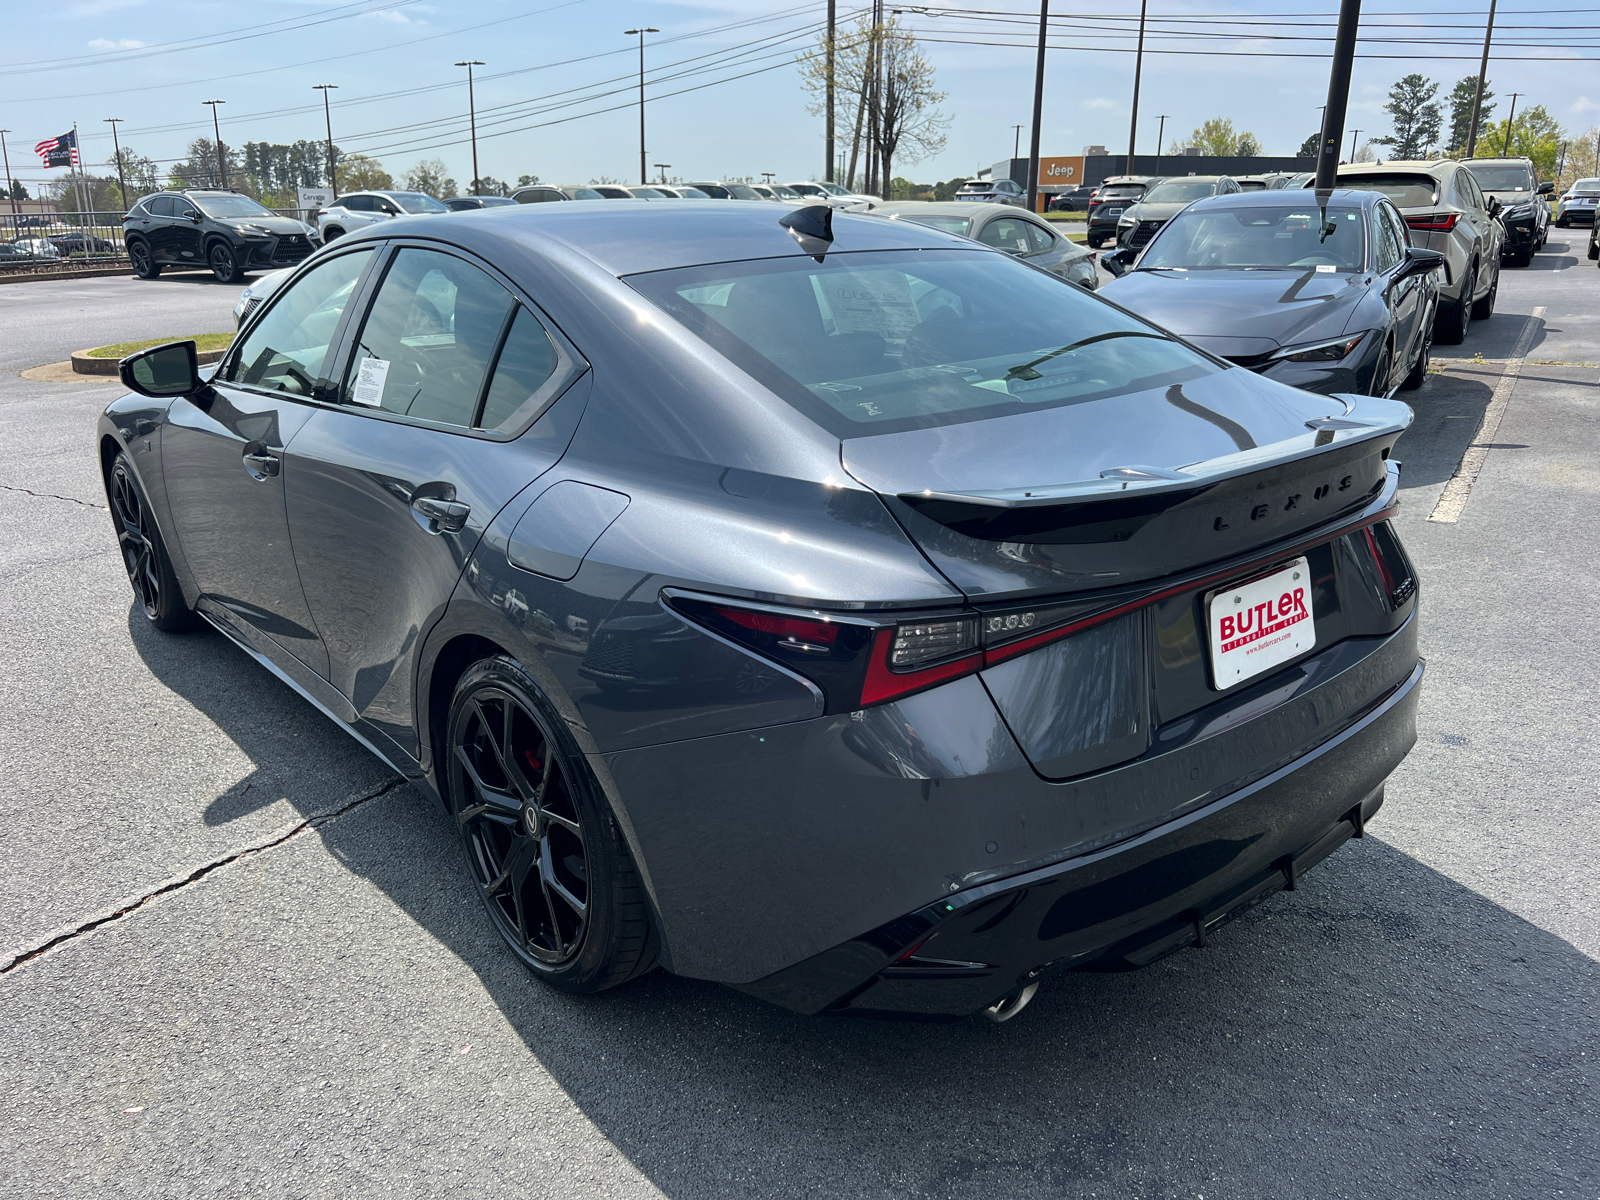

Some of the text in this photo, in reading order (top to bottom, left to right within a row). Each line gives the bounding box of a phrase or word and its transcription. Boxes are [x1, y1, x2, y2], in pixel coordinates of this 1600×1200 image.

[1047, 163, 1074, 178] Jeep
[1213, 475, 1352, 532] LEXUS
[1221, 626, 1277, 653] AUTOMOTIVE
[1283, 611, 1308, 628] GROUP
[1246, 632, 1291, 656] www.butlercars.com
